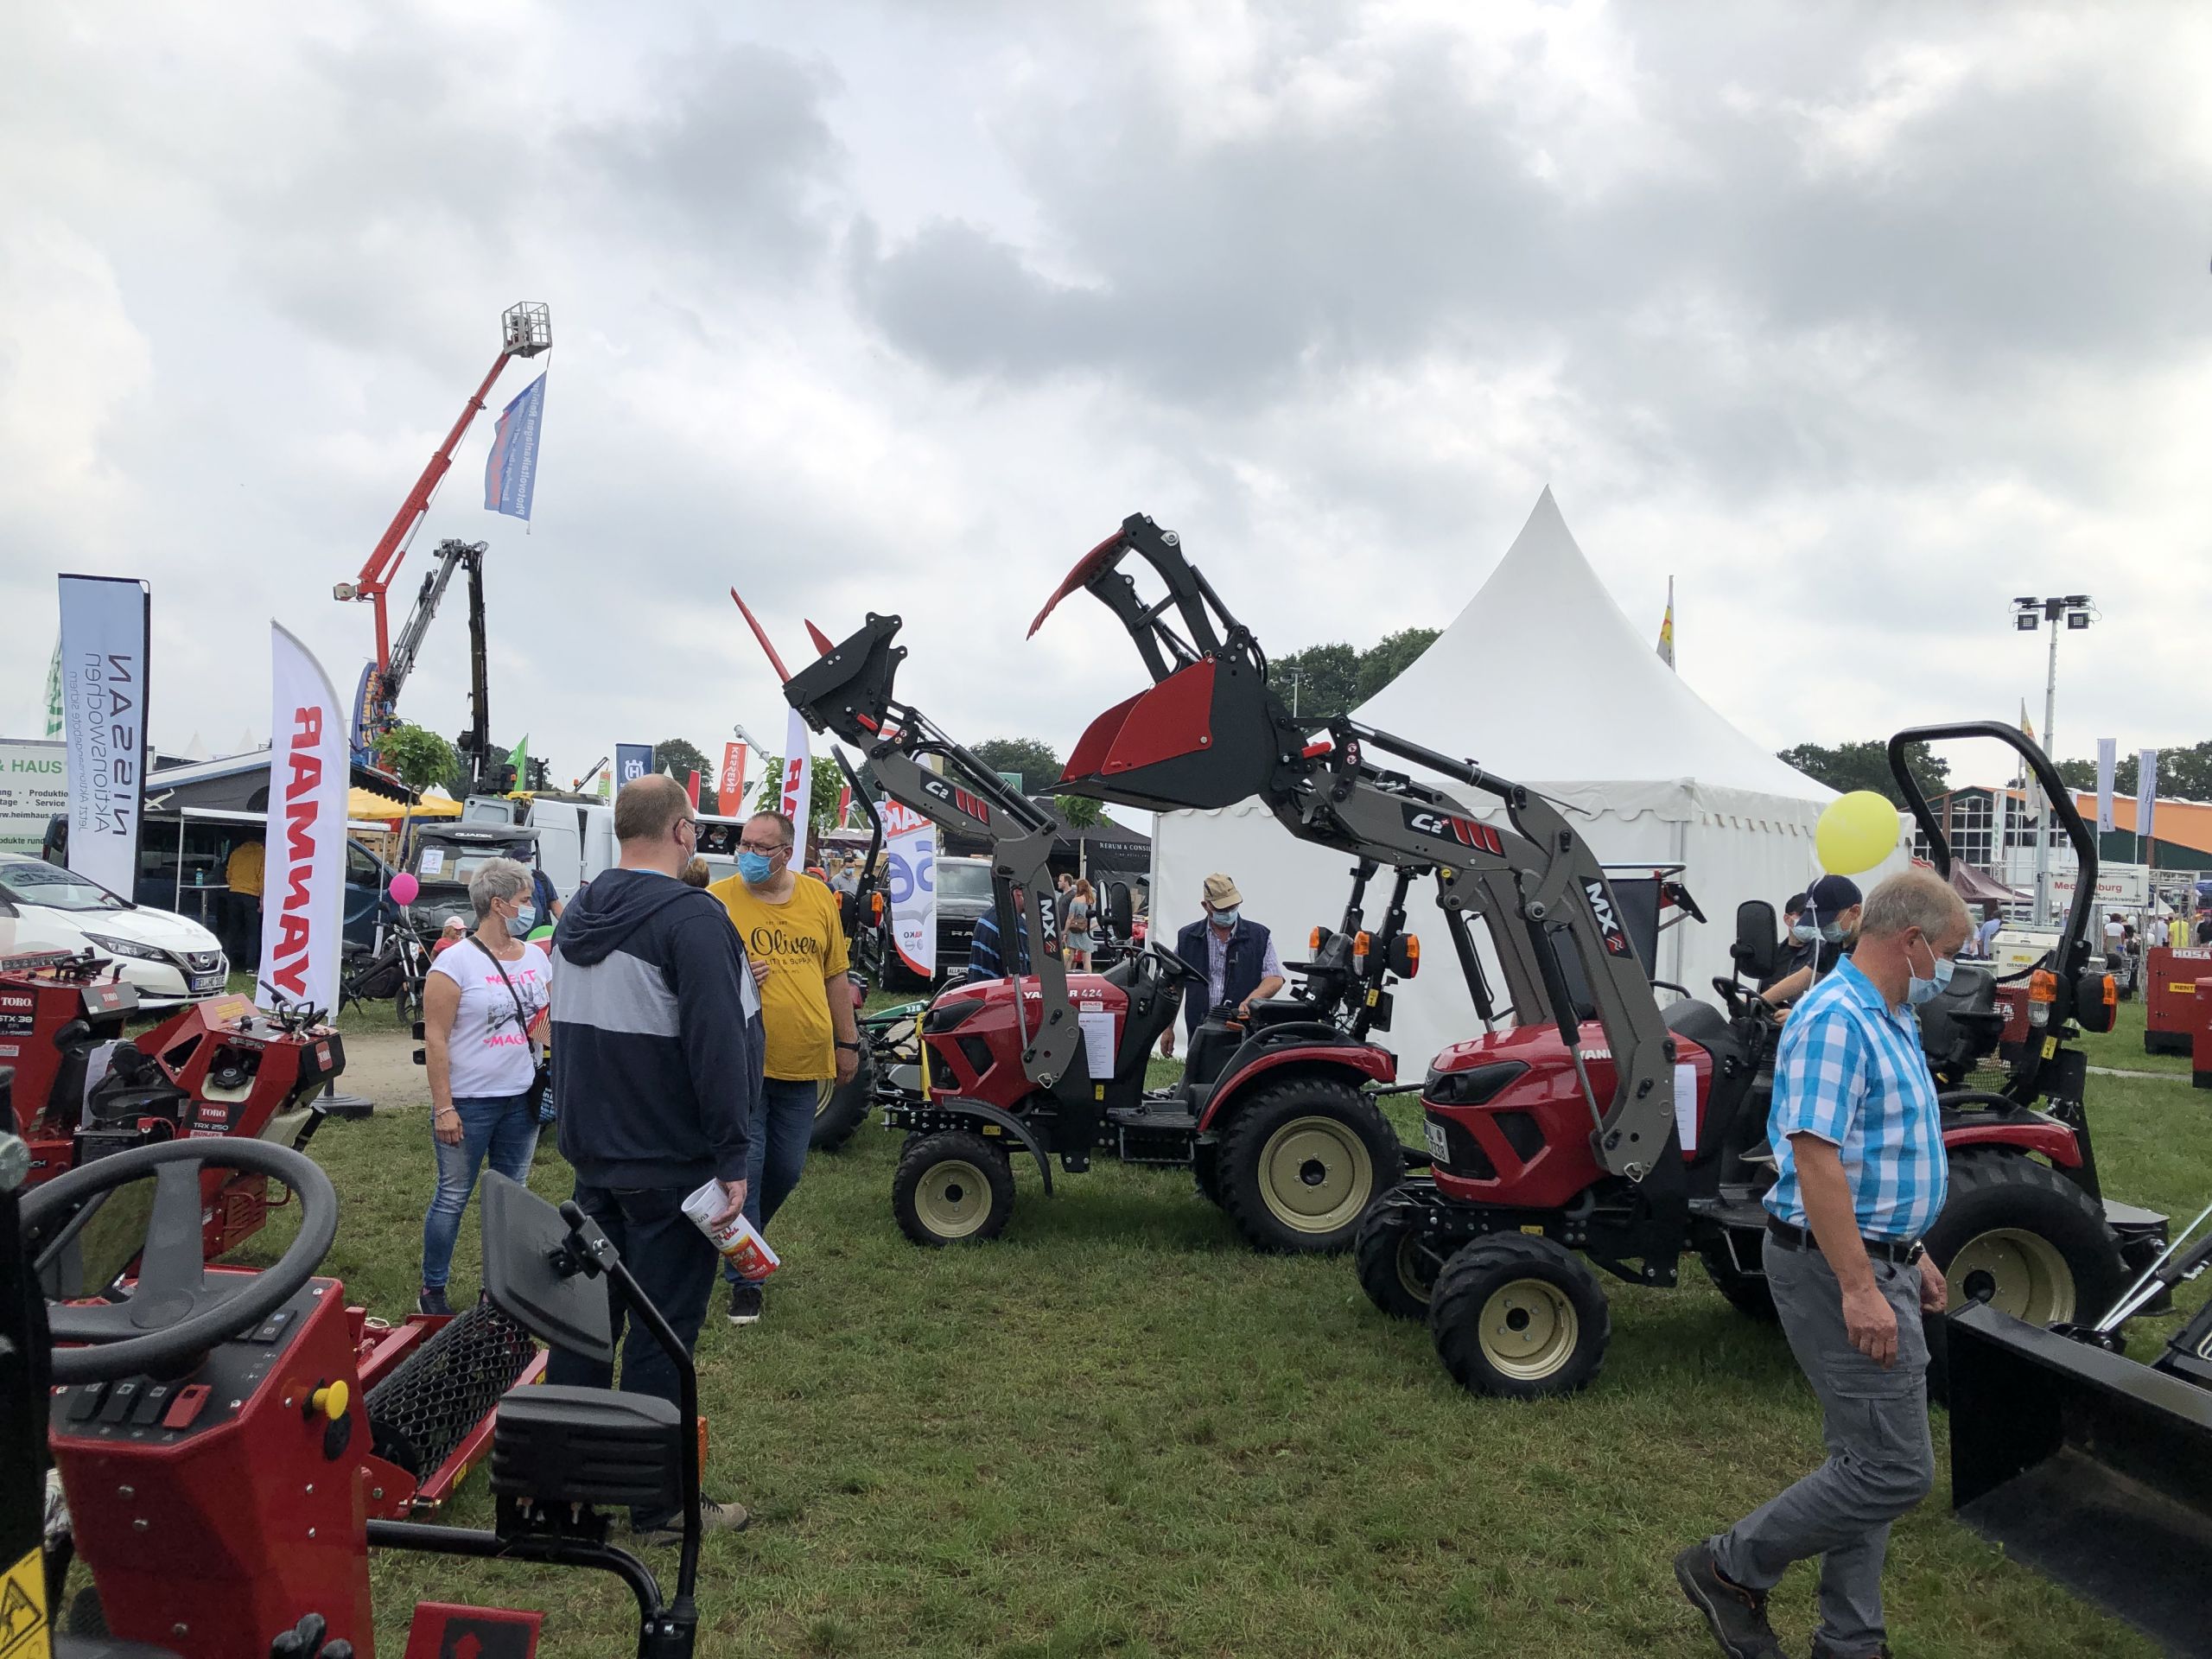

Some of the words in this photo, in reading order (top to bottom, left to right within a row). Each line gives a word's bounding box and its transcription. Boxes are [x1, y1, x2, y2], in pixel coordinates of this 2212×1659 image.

[11, 759, 63, 774] HAUS
[29, 789, 69, 798] Produktio
[925, 781, 949, 799] C2
[35, 799, 66, 808] Service
[2054, 881, 2123, 893] Mecburg
[1585, 881, 1619, 936] MX
[1039, 899, 1057, 939] MX
[2172, 949, 2211, 960] MOSA
[485, 974, 517, 985] MAE
[1081, 989, 1103, 998] 424
[1, 996, 33, 1007] TORO
[200, 1107, 227, 1117] TORO
[194, 1122, 211, 1130] TRX
[212, 1122, 229, 1131] 250
